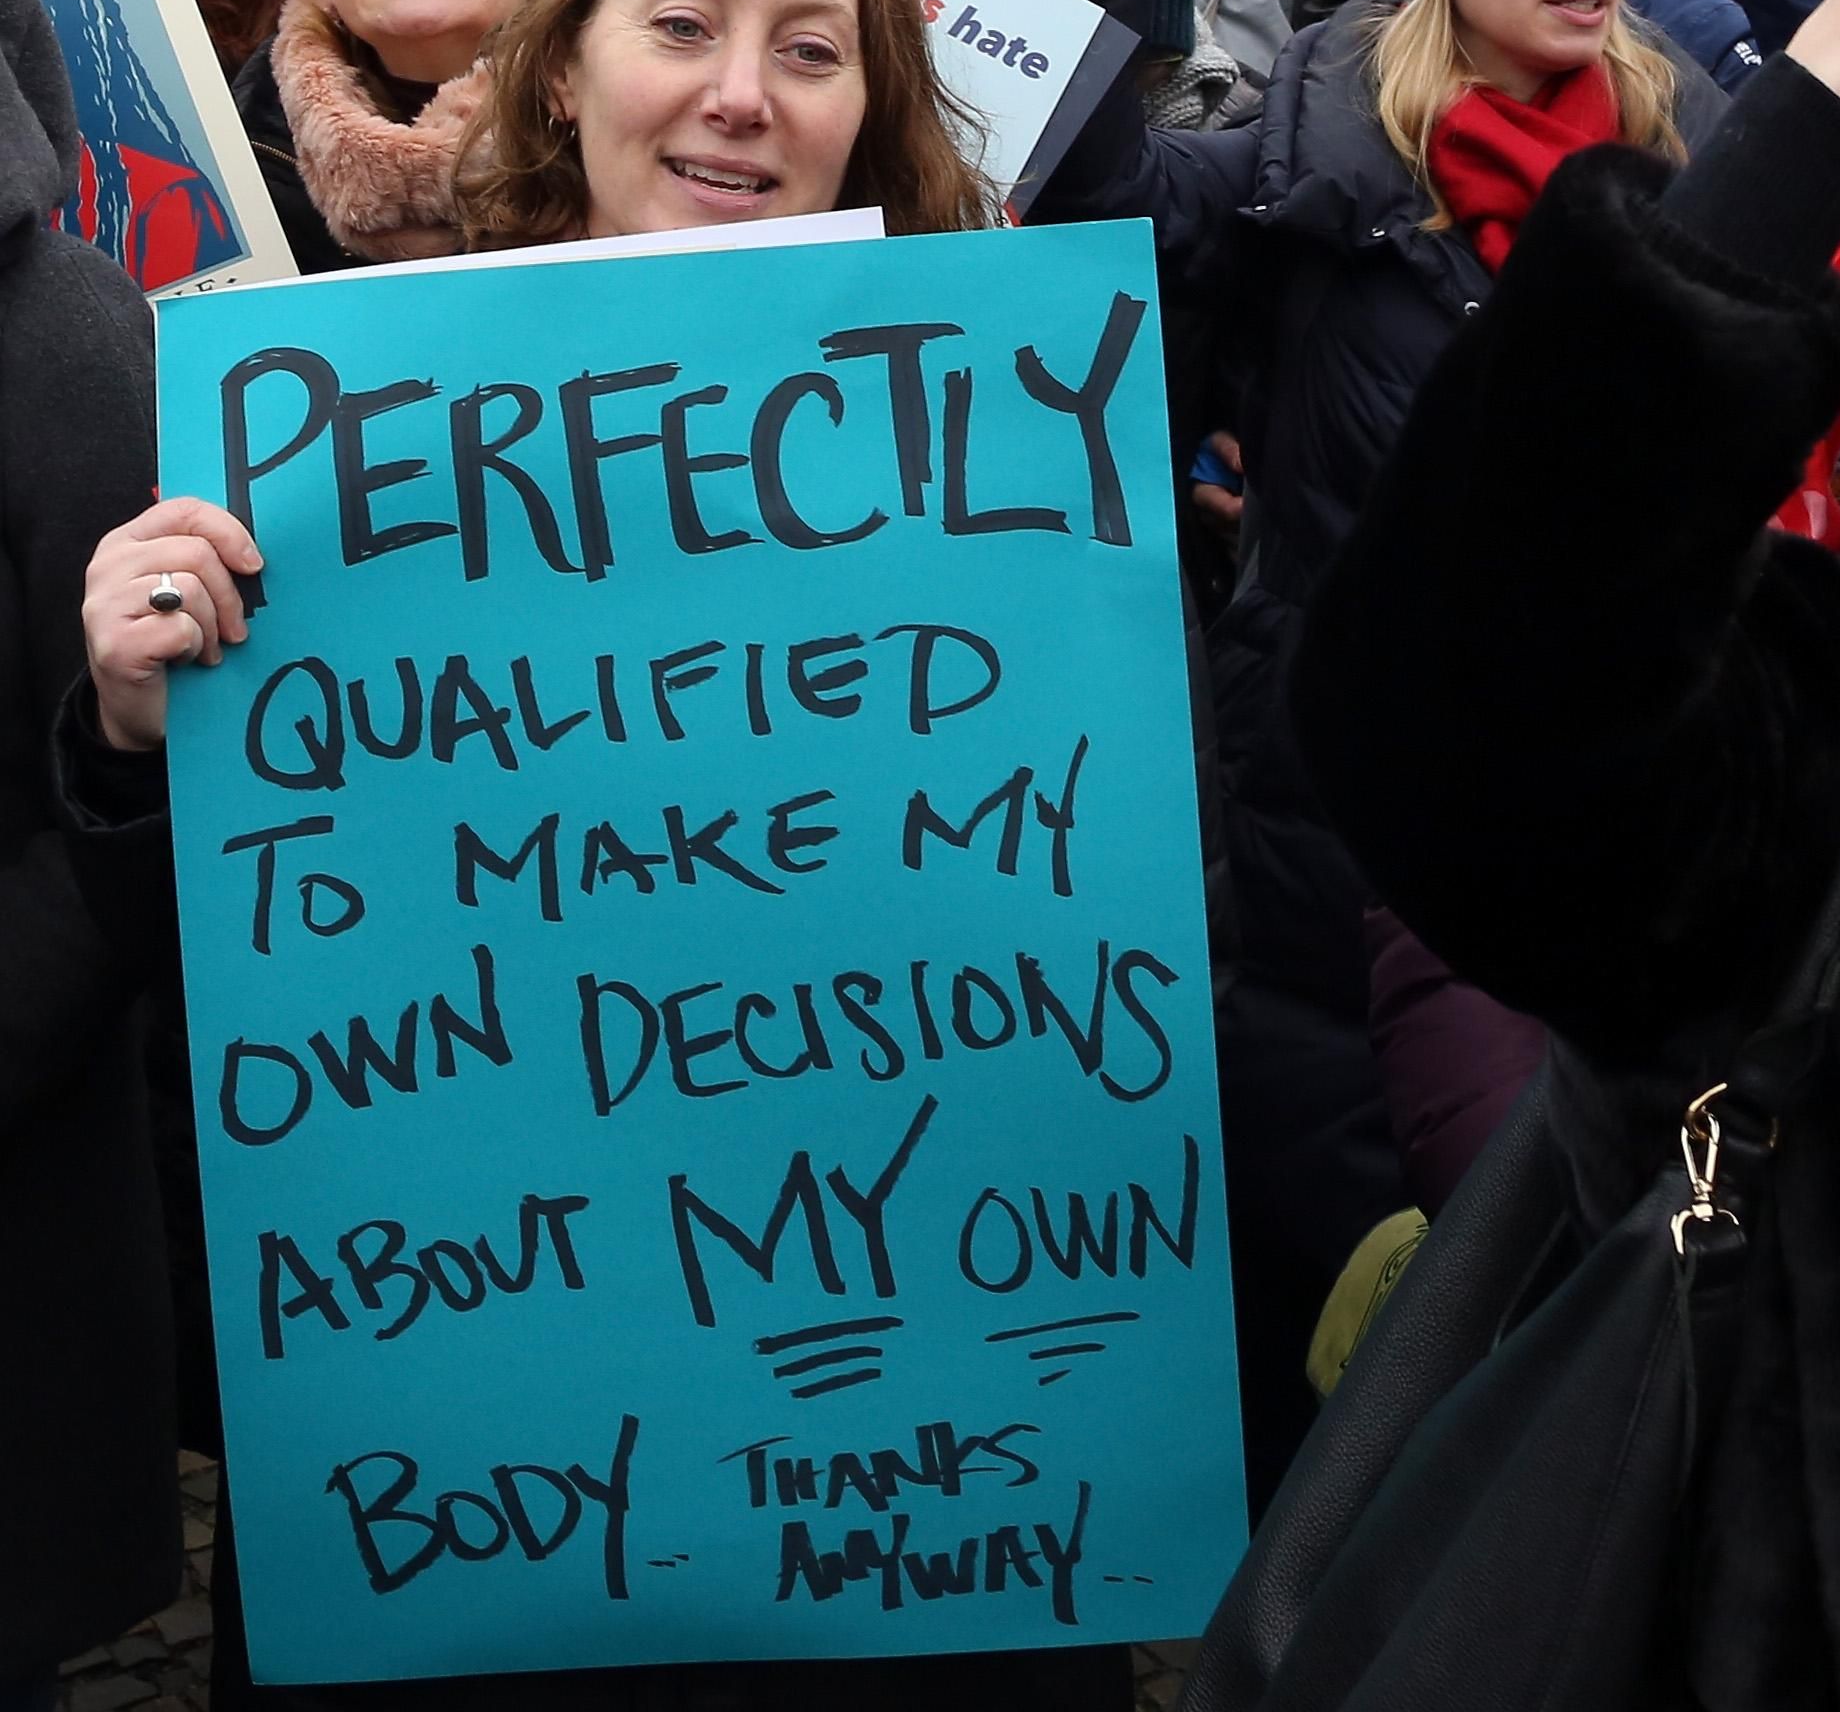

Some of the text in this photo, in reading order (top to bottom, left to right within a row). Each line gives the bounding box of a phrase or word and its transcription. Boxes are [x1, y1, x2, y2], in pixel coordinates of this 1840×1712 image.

[947, 5, 1051, 81] hate
[220, 289, 1148, 621] PERFECTLY
[246, 624, 1003, 793] QUALIFIED
[454, 790, 839, 924] MAKE
[902, 733, 1088, 898] MY
[218, 938, 1179, 1147] OWN DECISIONS
[262, 1096, 1203, 1360] ABOUT MY OWN
[716, 1420, 1042, 1513] THANKS
